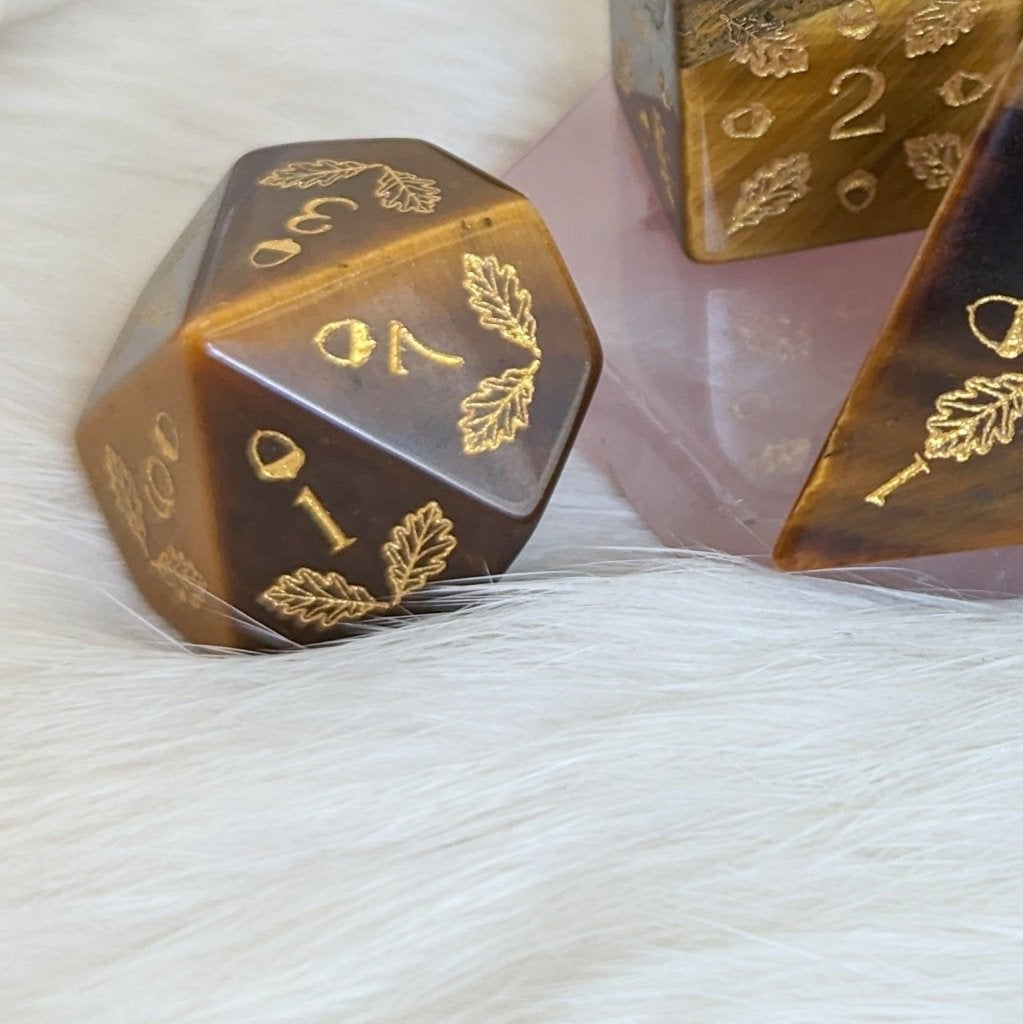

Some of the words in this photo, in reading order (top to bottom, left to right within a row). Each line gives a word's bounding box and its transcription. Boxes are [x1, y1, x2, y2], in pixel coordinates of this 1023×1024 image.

[828, 63, 887, 141] 2
[286, 195, 360, 236] 3
[388, 319, 466, 377] 7
[863, 452, 933, 508] 1
[293, 484, 359, 555] 1
